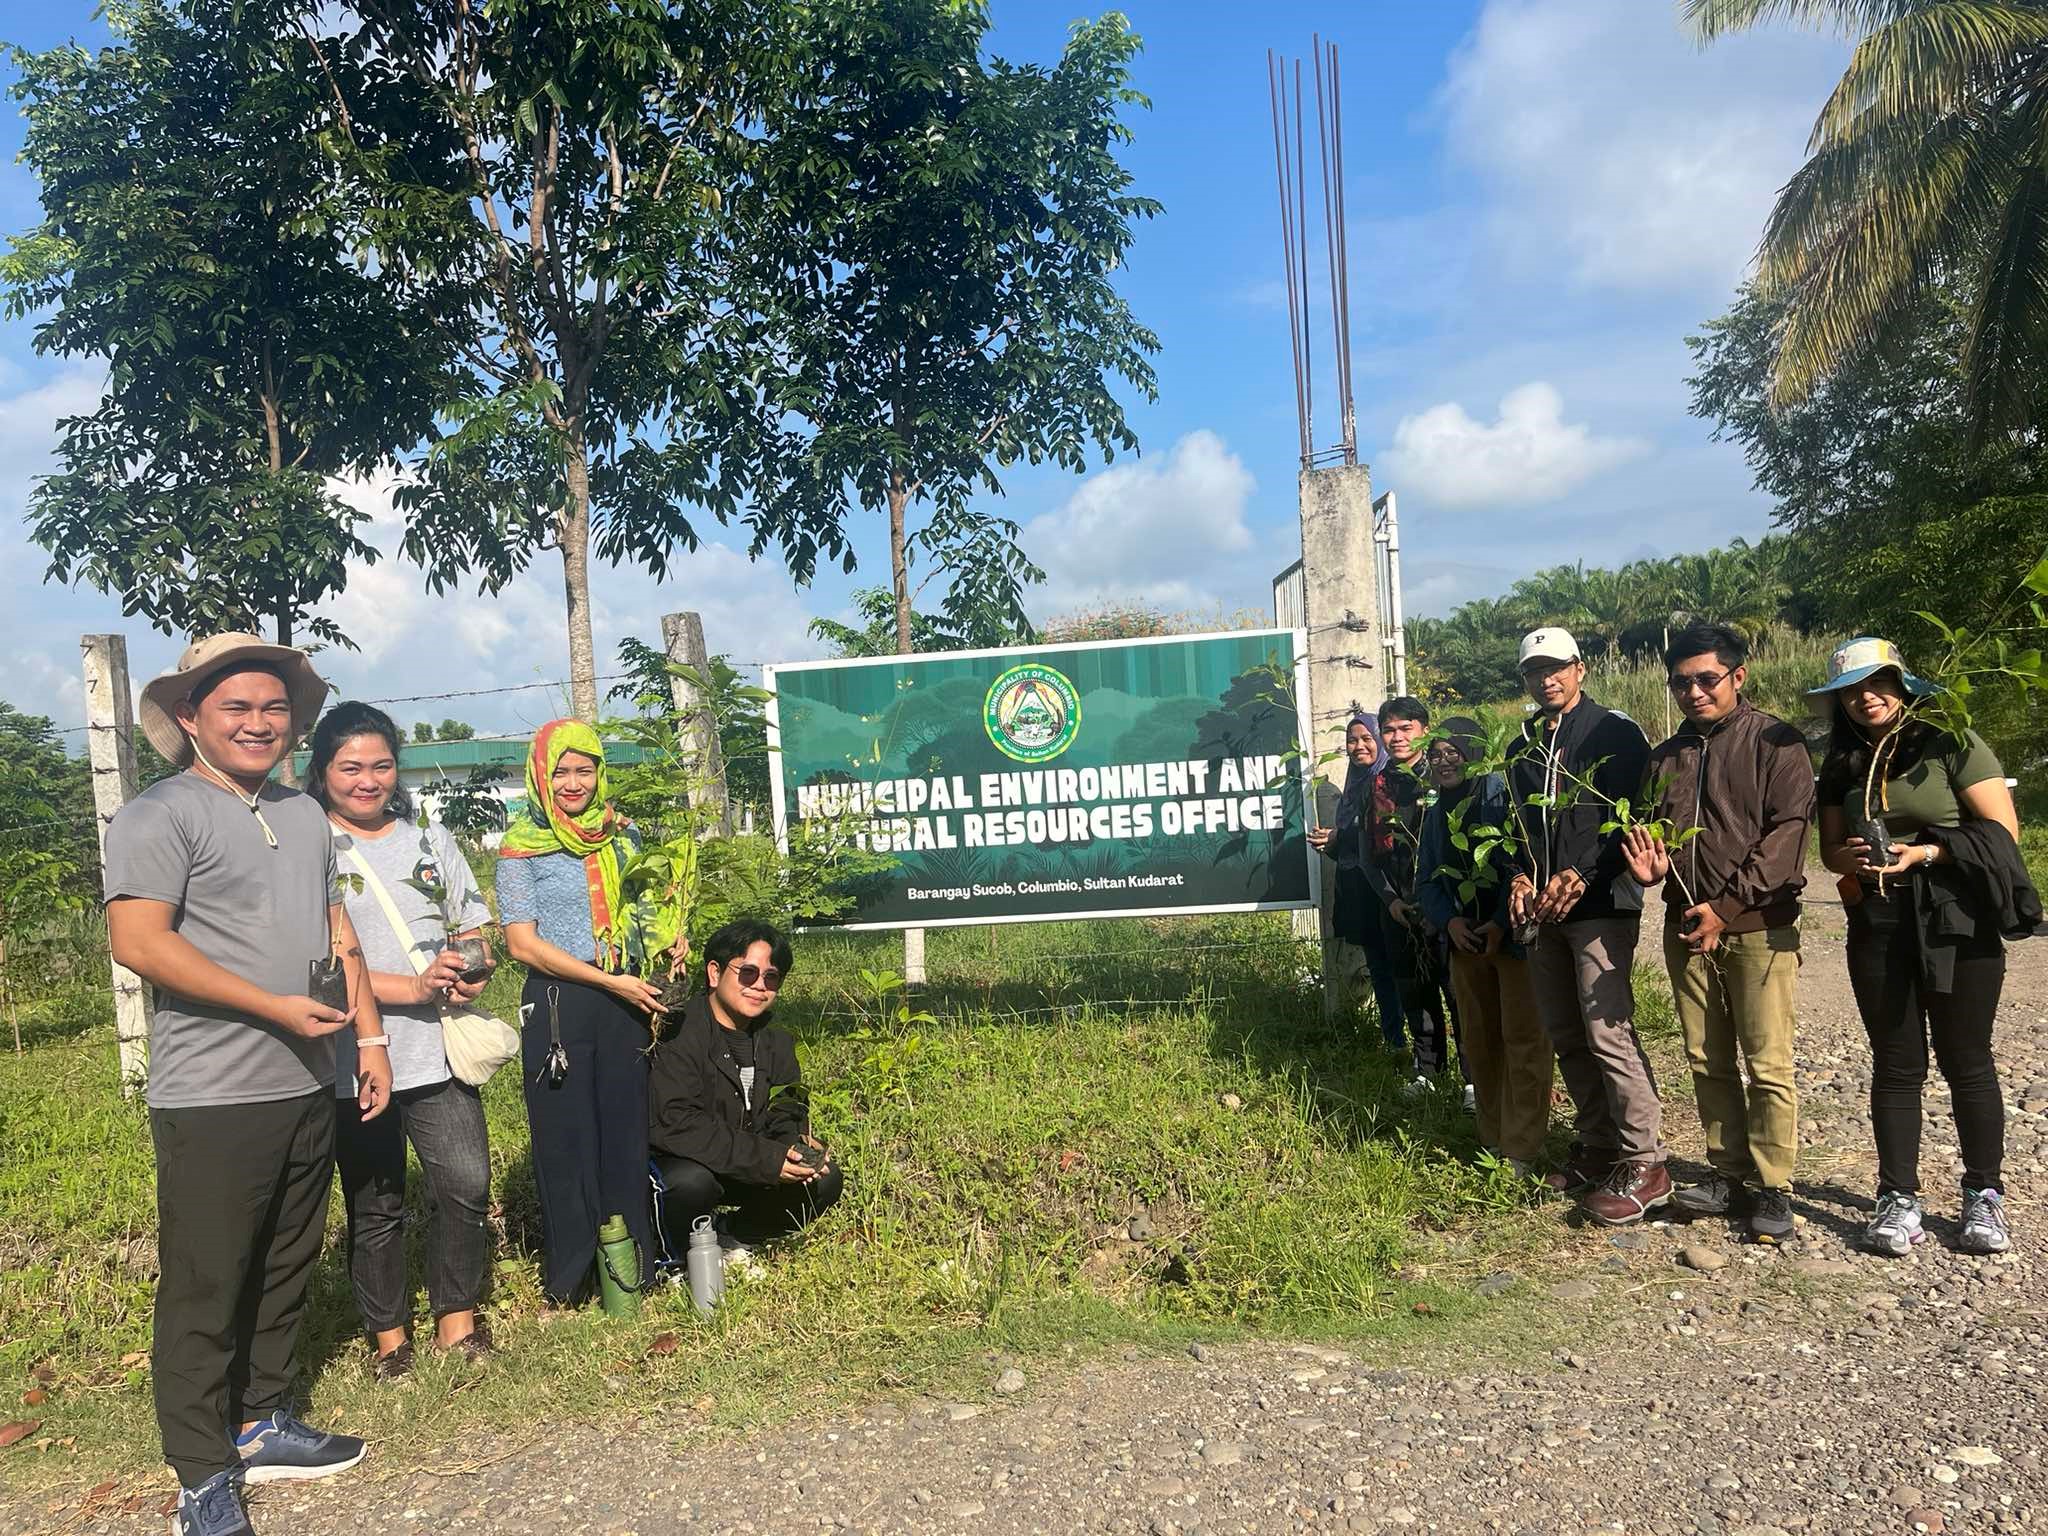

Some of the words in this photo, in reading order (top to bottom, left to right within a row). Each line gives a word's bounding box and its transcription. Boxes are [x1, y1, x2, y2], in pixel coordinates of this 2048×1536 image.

[1535, 635, 1545, 644] P
[989, 671, 1029, 715] MUNICIPALITY
[1031, 671, 1044, 679] OF
[1045, 674, 1075, 709] COLUMBIO
[798, 776, 974, 819] MUNICIPAL
[980, 760, 1210, 807] ENVIRONMENT
[1219, 755, 1287, 792] AND
[806, 816, 957, 853] TURAL
[963, 803, 1153, 847] RESOURCES
[1161, 795, 1284, 836] OFFICE
[907, 886, 971, 901] Barangay
[973, 882, 1016, 896] Sucob,
[1017, 879, 1082, 894] Columbio,
[1084, 877, 1126, 890] Sultan
[1128, 874, 1184, 888] Kudarat
